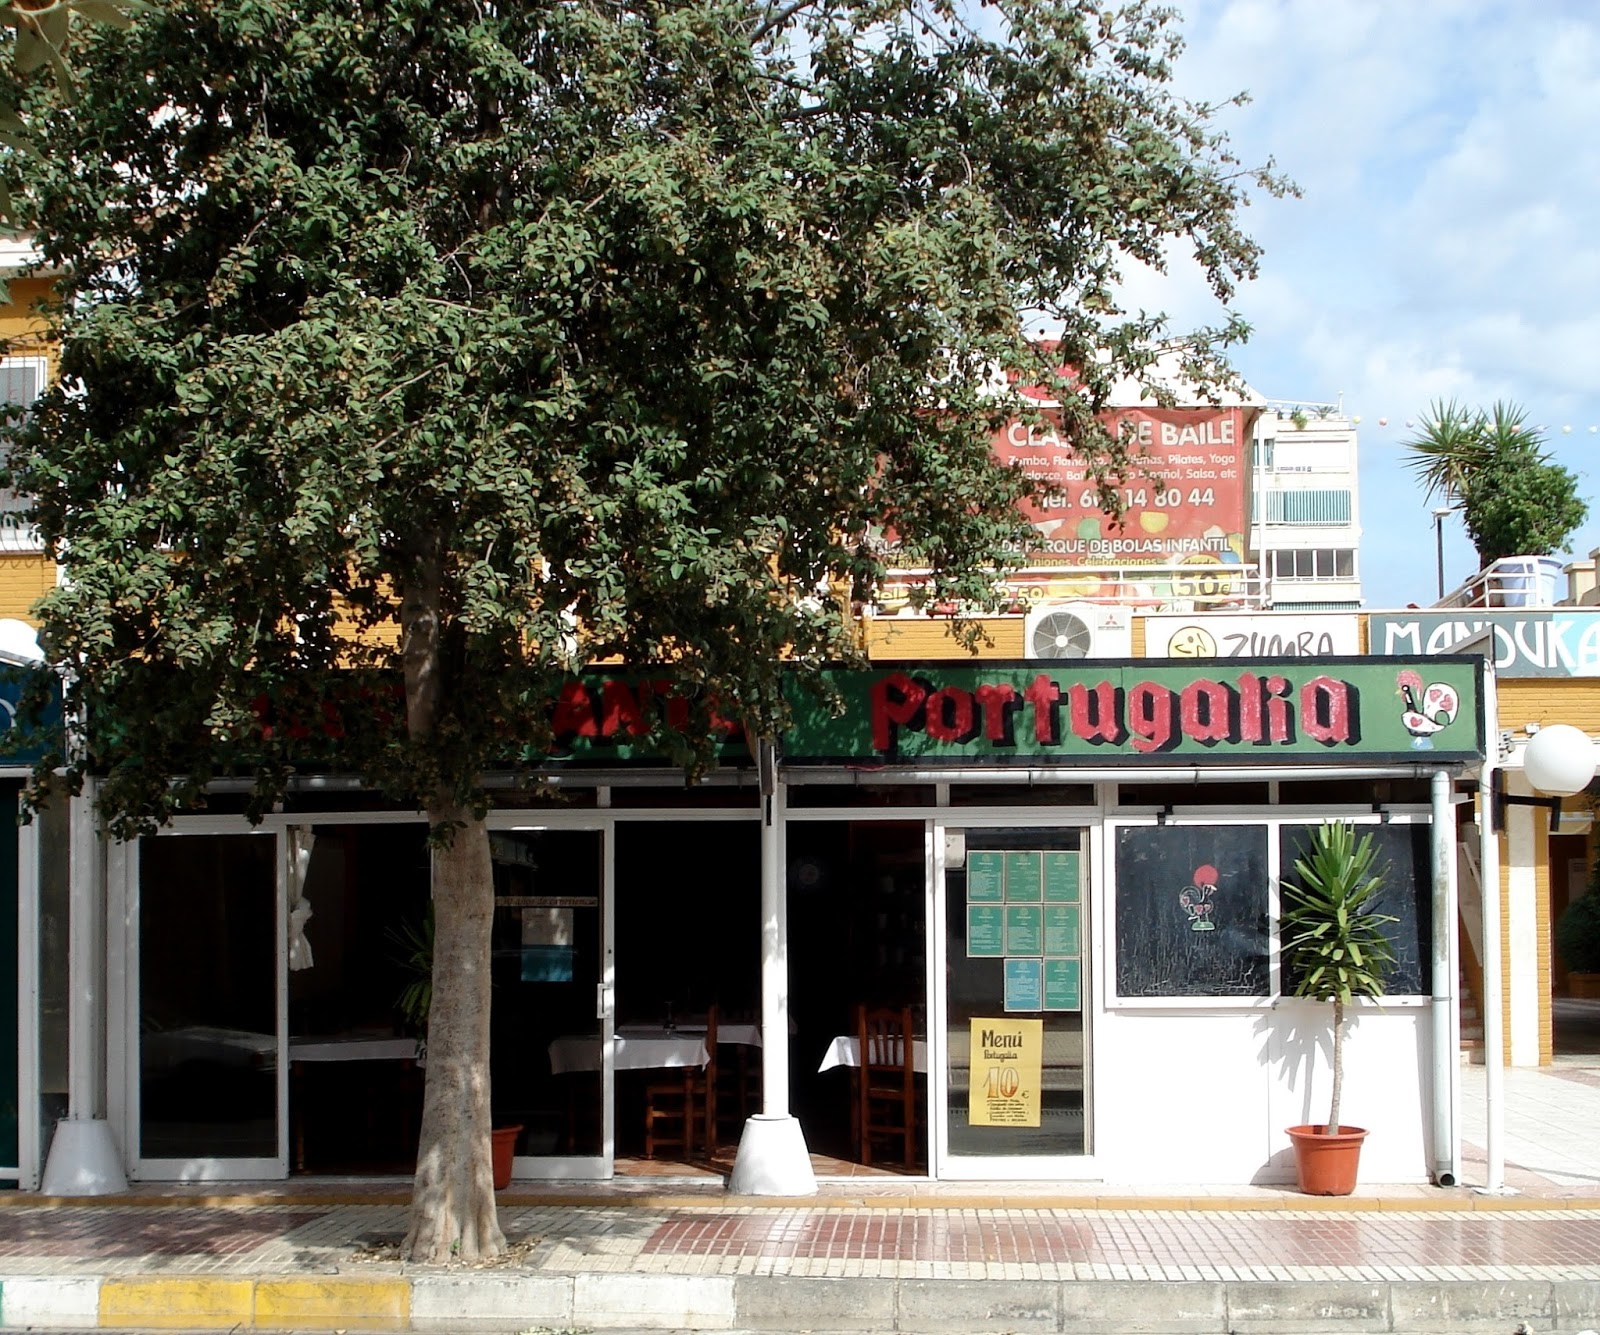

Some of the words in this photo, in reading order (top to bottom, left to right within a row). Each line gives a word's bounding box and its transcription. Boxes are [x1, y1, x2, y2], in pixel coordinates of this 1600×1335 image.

[1161, 419, 1235, 445] BAILE
[1168, 453, 1206, 466] Pilates,
[1209, 453, 1236, 466] Yoga
[1138, 468, 1183, 481] Epañol,
[1186, 468, 1217, 481] Salsa,
[1220, 469, 1238, 479] etc
[1125, 488, 1148, 508] 14
[1187, 487, 1215, 506] 44
[1090, 539, 1108, 553] DE
[1112, 539, 1162, 553] BOLAS
[1167, 538, 1232, 552] INFANTIL
[1223, 632, 1335, 657] ZUMBA
[868, 671, 1356, 753] Portugalia
